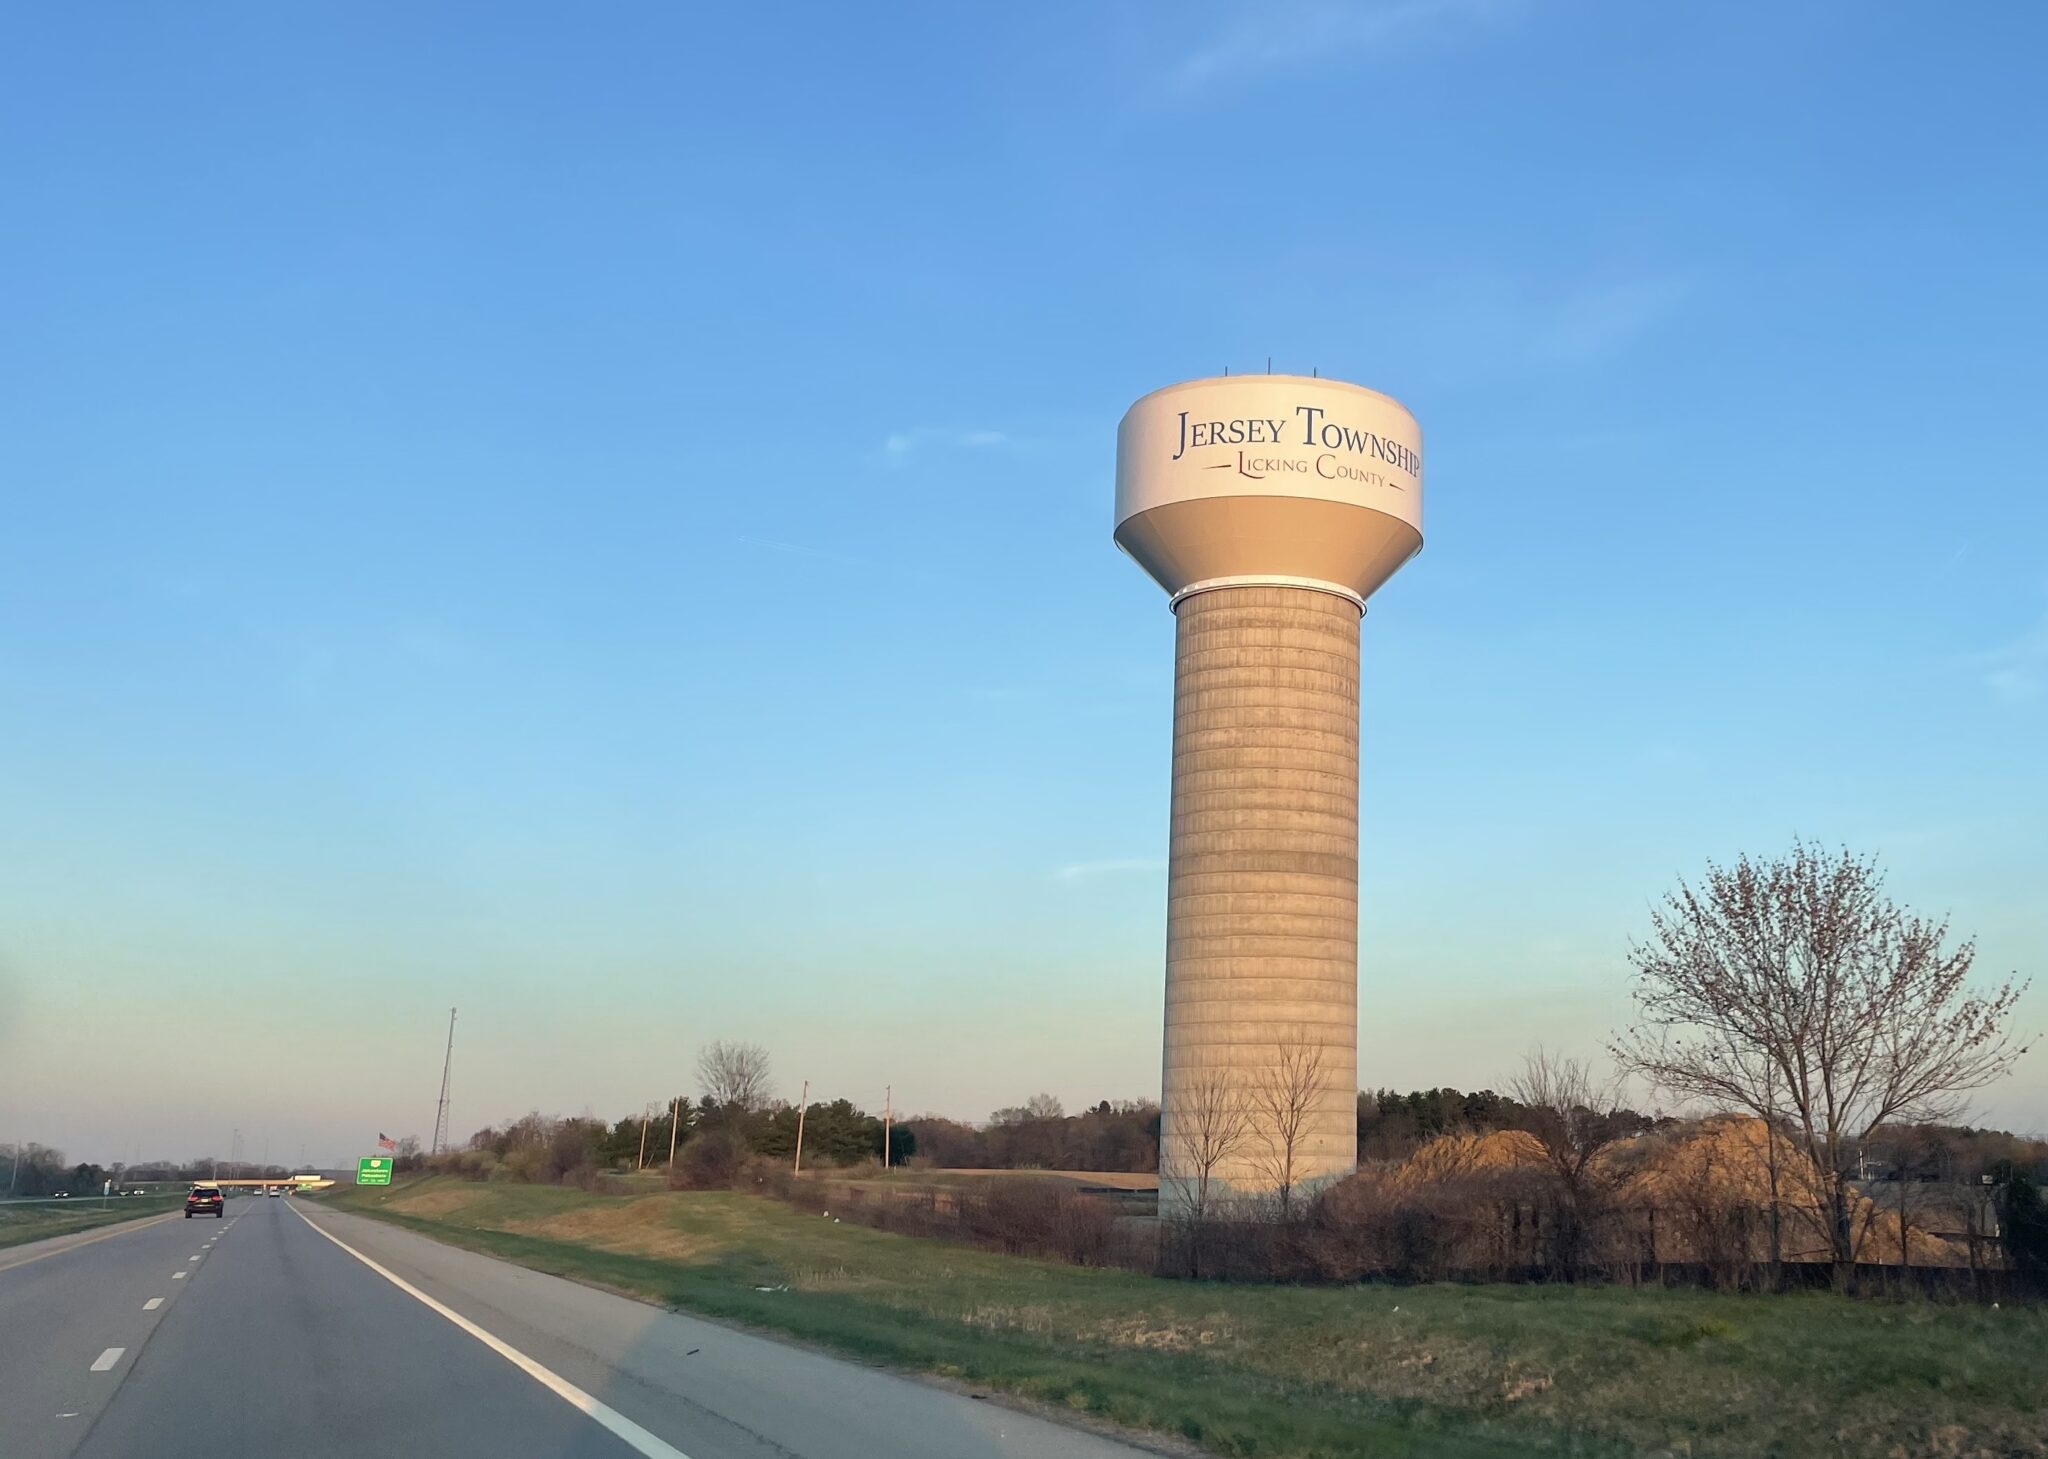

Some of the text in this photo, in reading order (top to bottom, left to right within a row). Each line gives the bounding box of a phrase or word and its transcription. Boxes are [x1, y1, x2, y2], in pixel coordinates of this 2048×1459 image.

[1172, 406, 1420, 478] JERSEY TOWNSHIP
[1237, 451, 1385, 487] LICKING COUNTY
